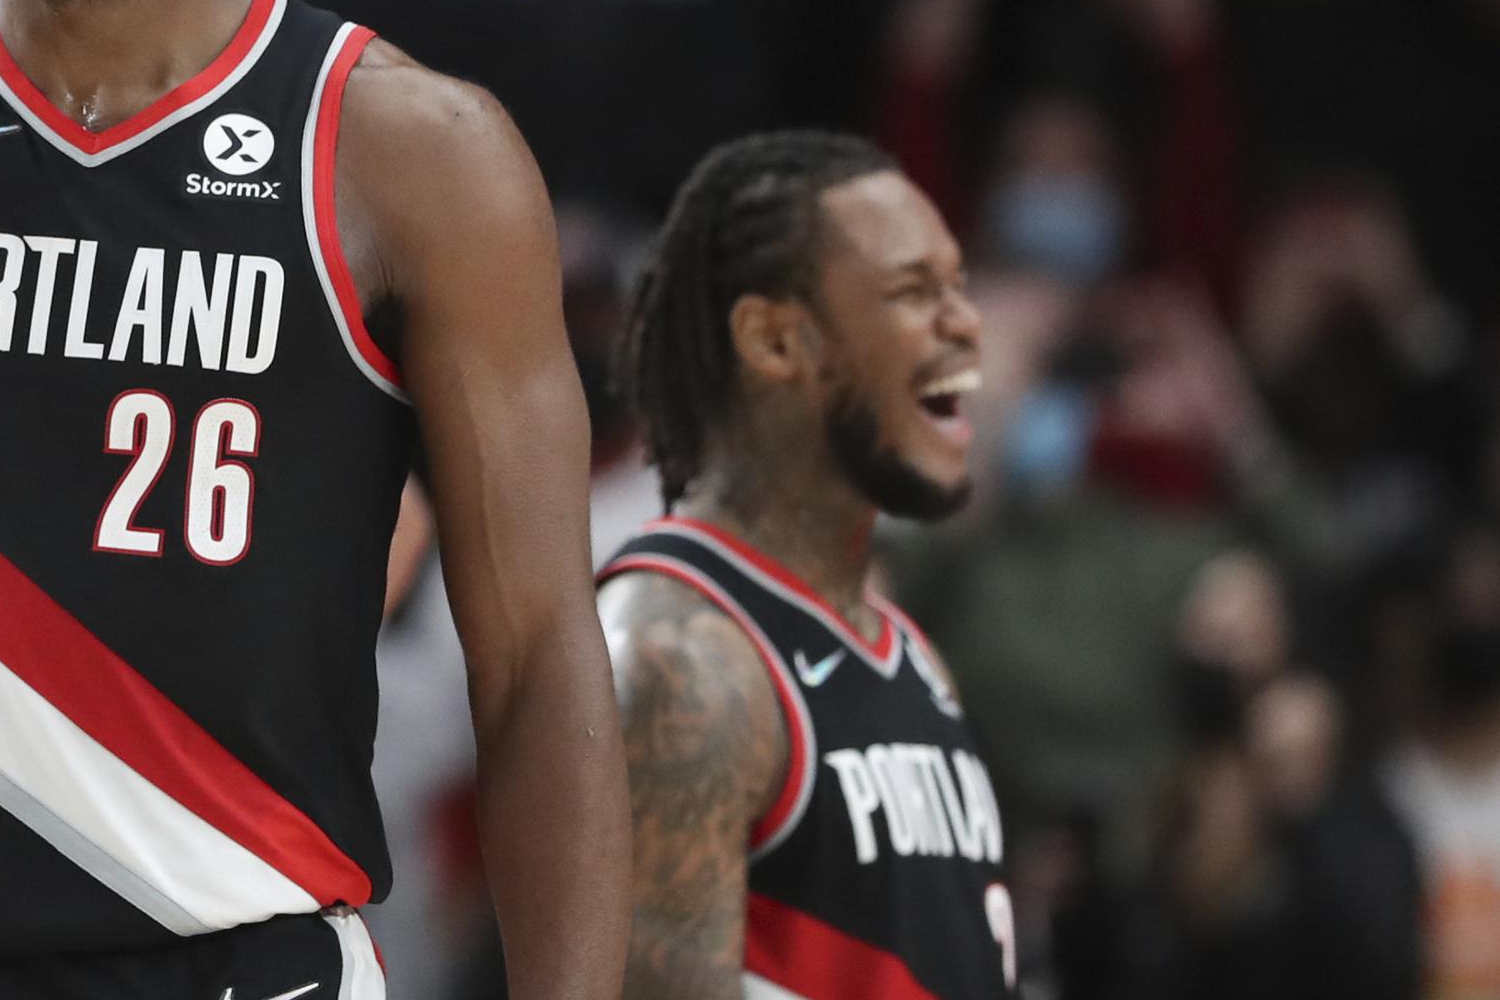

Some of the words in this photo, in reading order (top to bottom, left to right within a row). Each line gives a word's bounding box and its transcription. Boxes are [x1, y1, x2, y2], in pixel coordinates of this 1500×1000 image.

[186, 173, 282, 200] StormX
[92, 388, 262, 567] 26
[822, 741, 1004, 865] PORTLA
